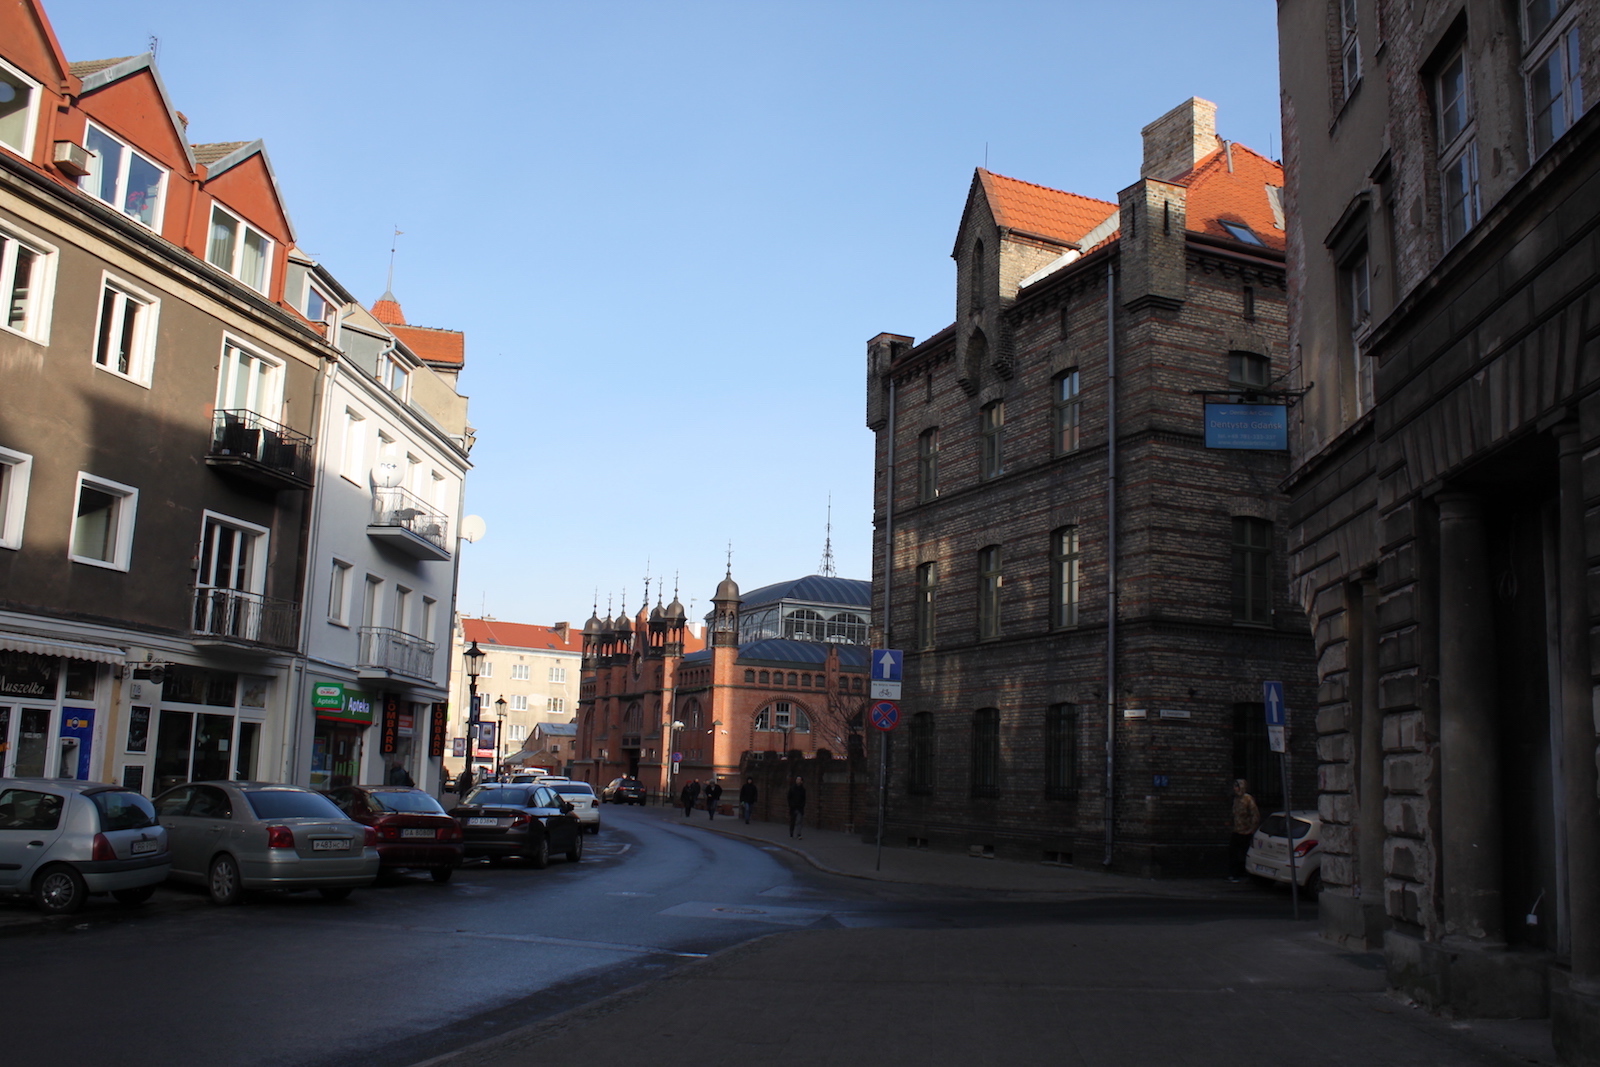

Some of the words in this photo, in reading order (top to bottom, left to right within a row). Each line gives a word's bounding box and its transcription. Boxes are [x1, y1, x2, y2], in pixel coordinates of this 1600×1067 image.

[1210, 420, 1248, 430] Dentysta
[1250, 421, 1283, 430] Gdańsk
[317, 697, 339, 706] Apteka
[348, 696, 370, 715] Apteka
[385, 696, 398, 753] LOMBARD
[432, 704, 443, 756] LOMBARD
